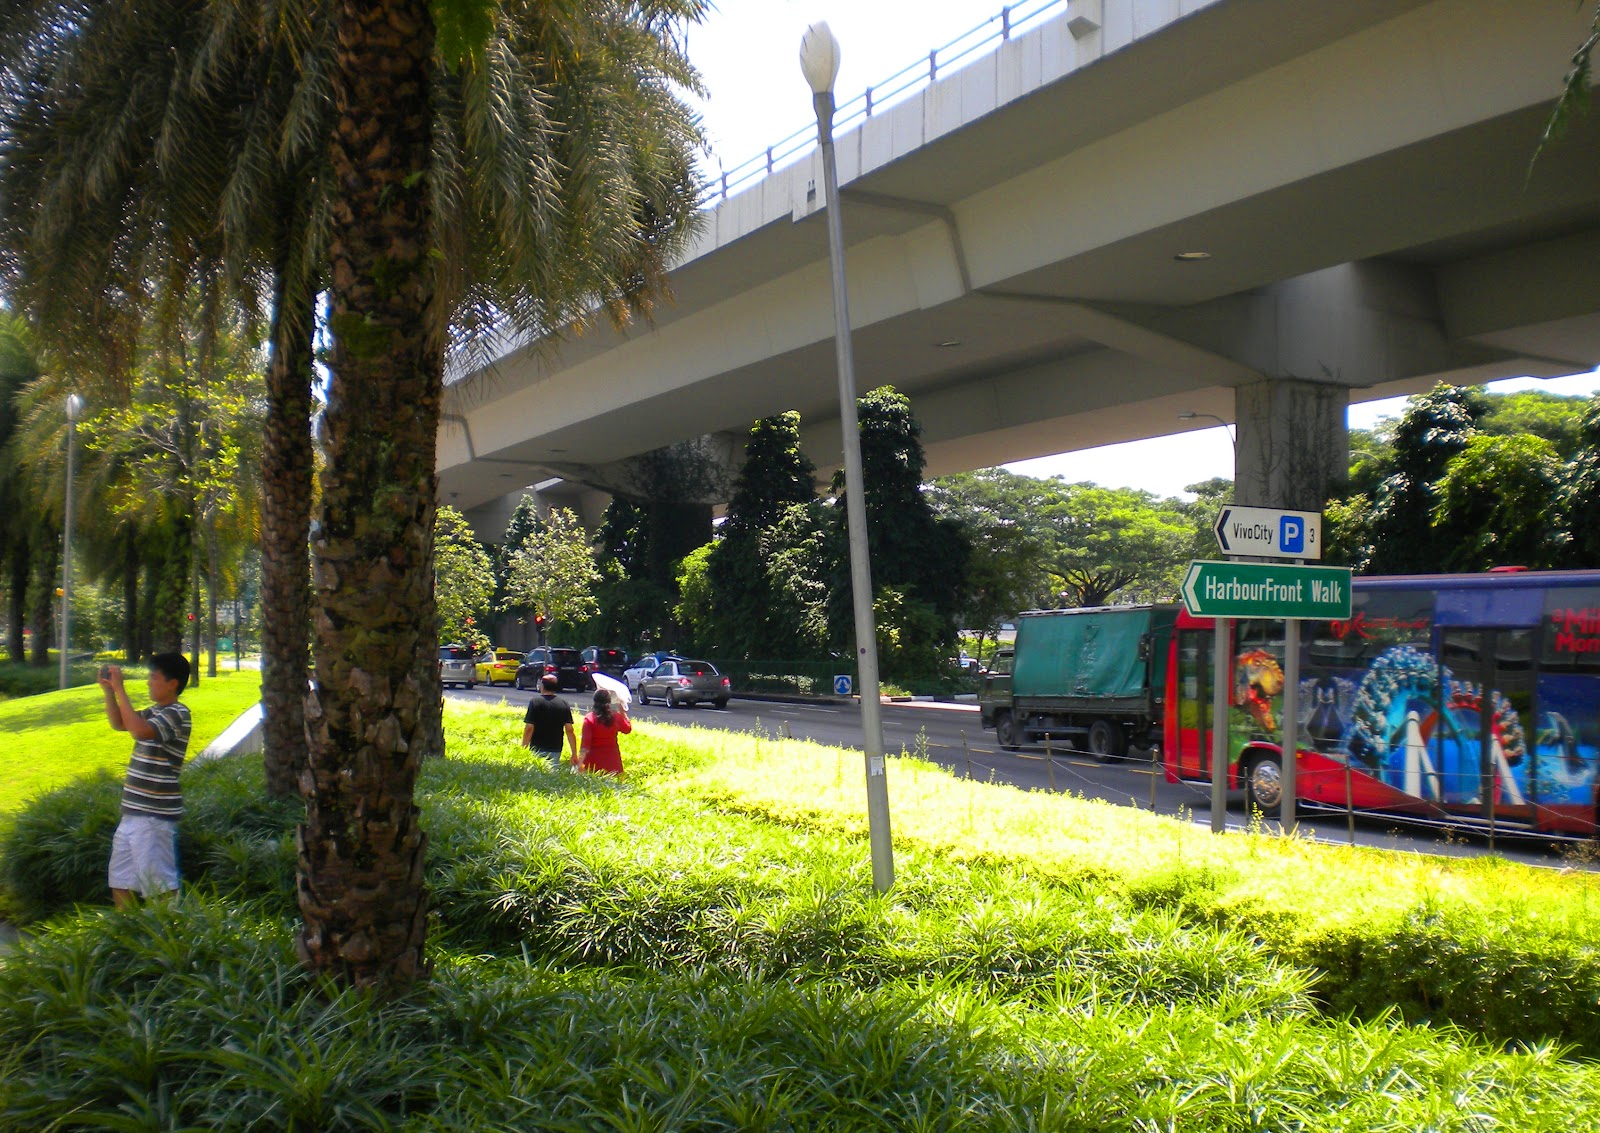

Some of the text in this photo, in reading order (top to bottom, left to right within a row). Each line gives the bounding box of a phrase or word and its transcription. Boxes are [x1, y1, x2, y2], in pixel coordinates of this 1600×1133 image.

[1233, 522, 1315, 546] VivoCity P 3
[1205, 575, 1342, 603] HarbourFront Walk
